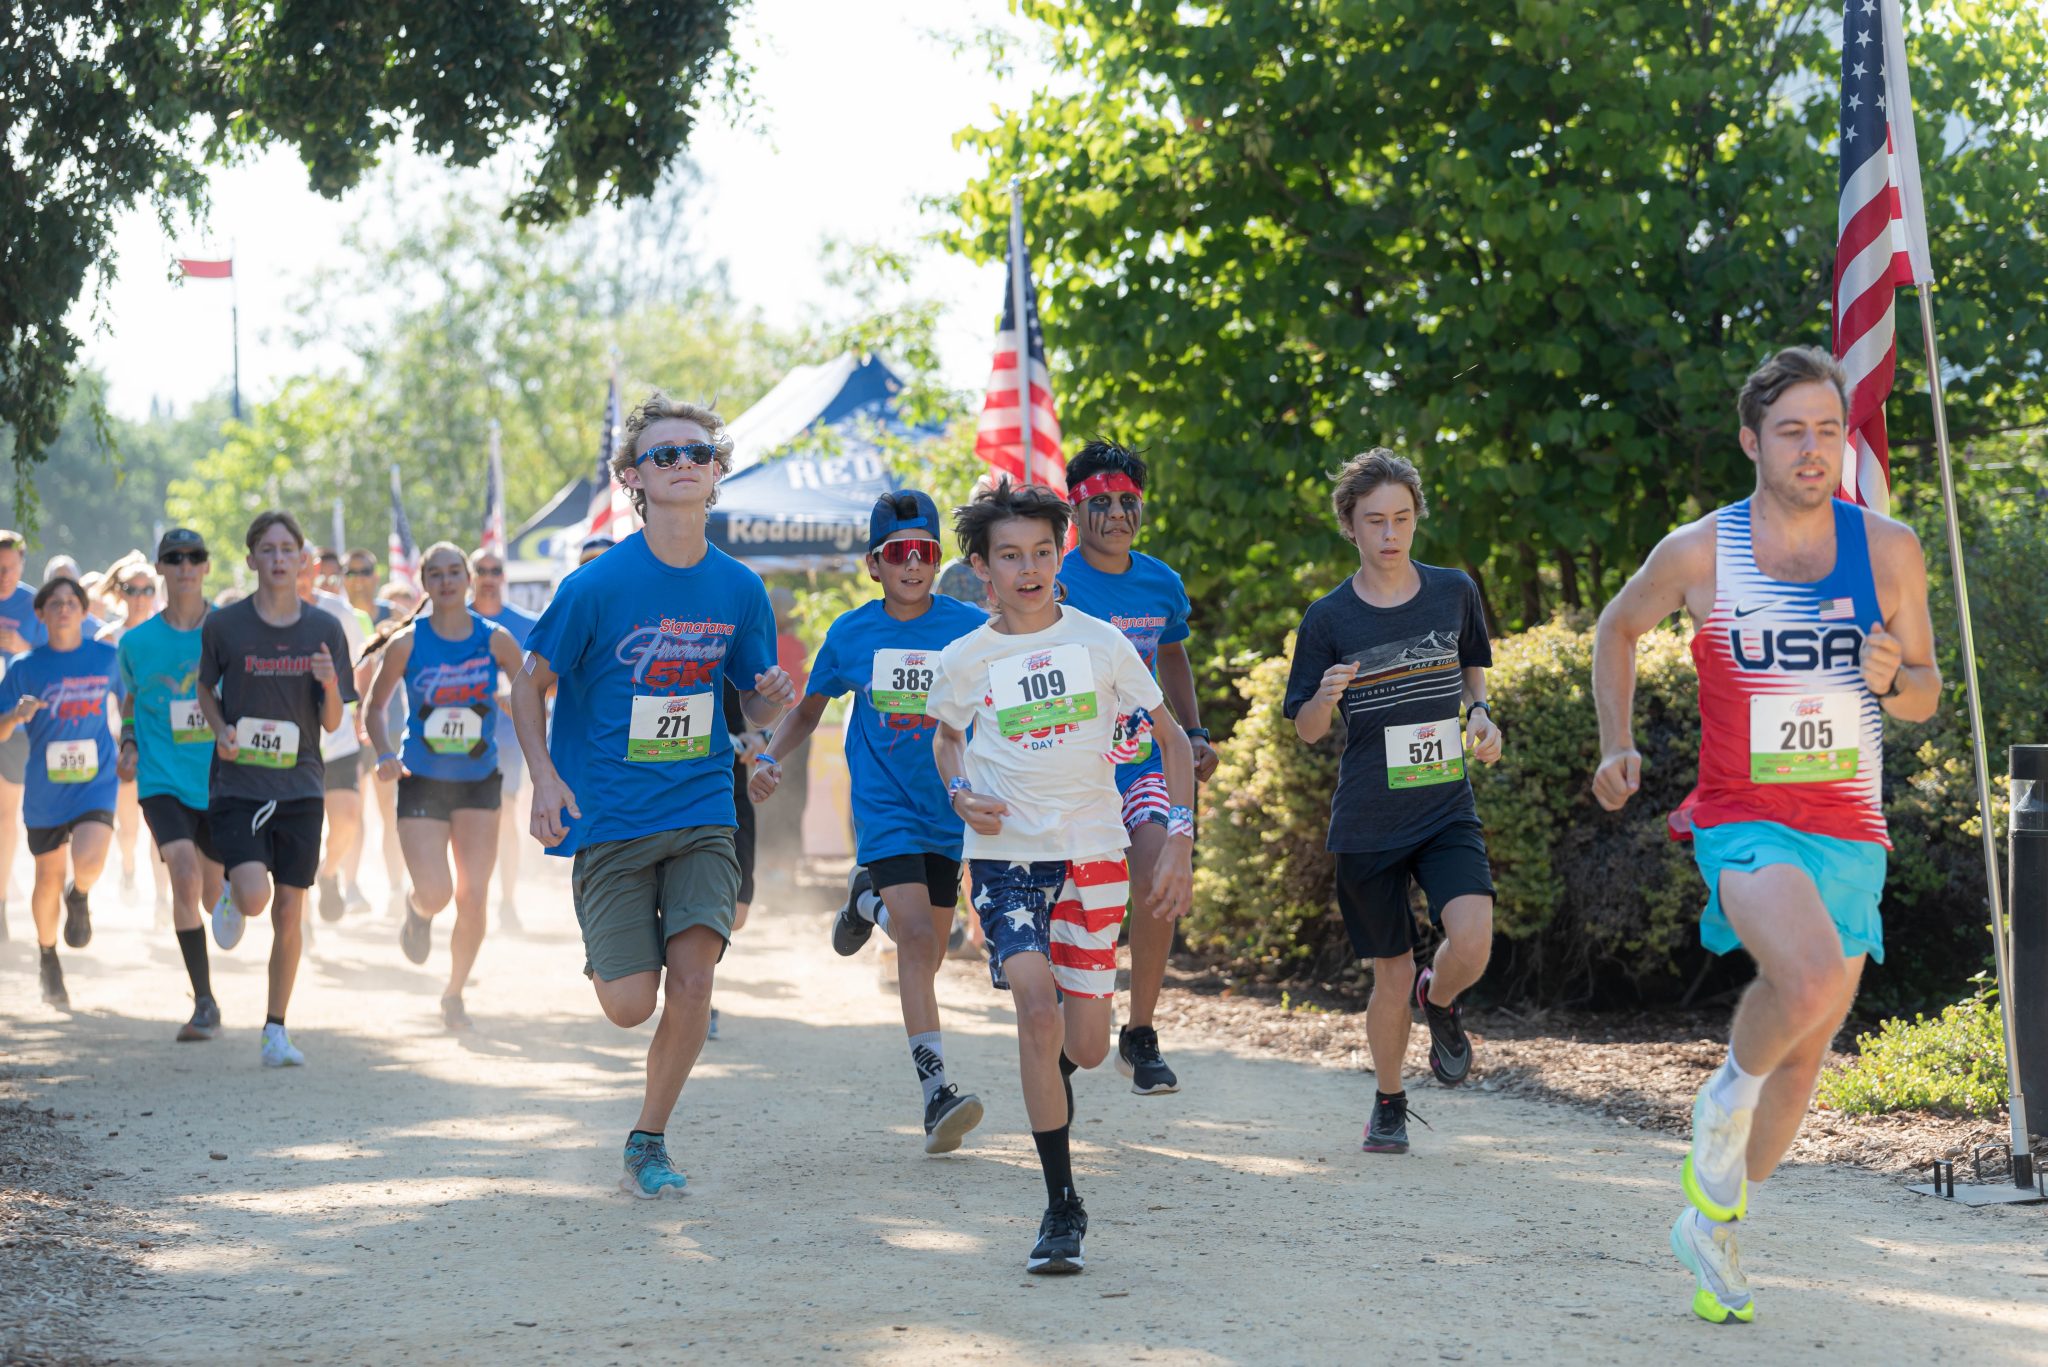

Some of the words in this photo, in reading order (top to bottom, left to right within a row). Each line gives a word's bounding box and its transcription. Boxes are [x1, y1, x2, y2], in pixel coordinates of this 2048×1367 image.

[1731, 629, 1863, 671] USA
[645, 660, 720, 688] 5K
[1409, 661, 1433, 670] LAKE
[892, 667, 933, 691] 383
[1018, 669, 1066, 702] 109
[1347, 685, 1396, 700] CALIFORNIA
[442, 721, 465, 735] 471
[656, 714, 690, 738] 271
[1780, 720, 1833, 750] 205
[251, 733, 281, 750] 454
[1031, 739, 1053, 750] DAY
[1409, 739, 1443, 764] 521
